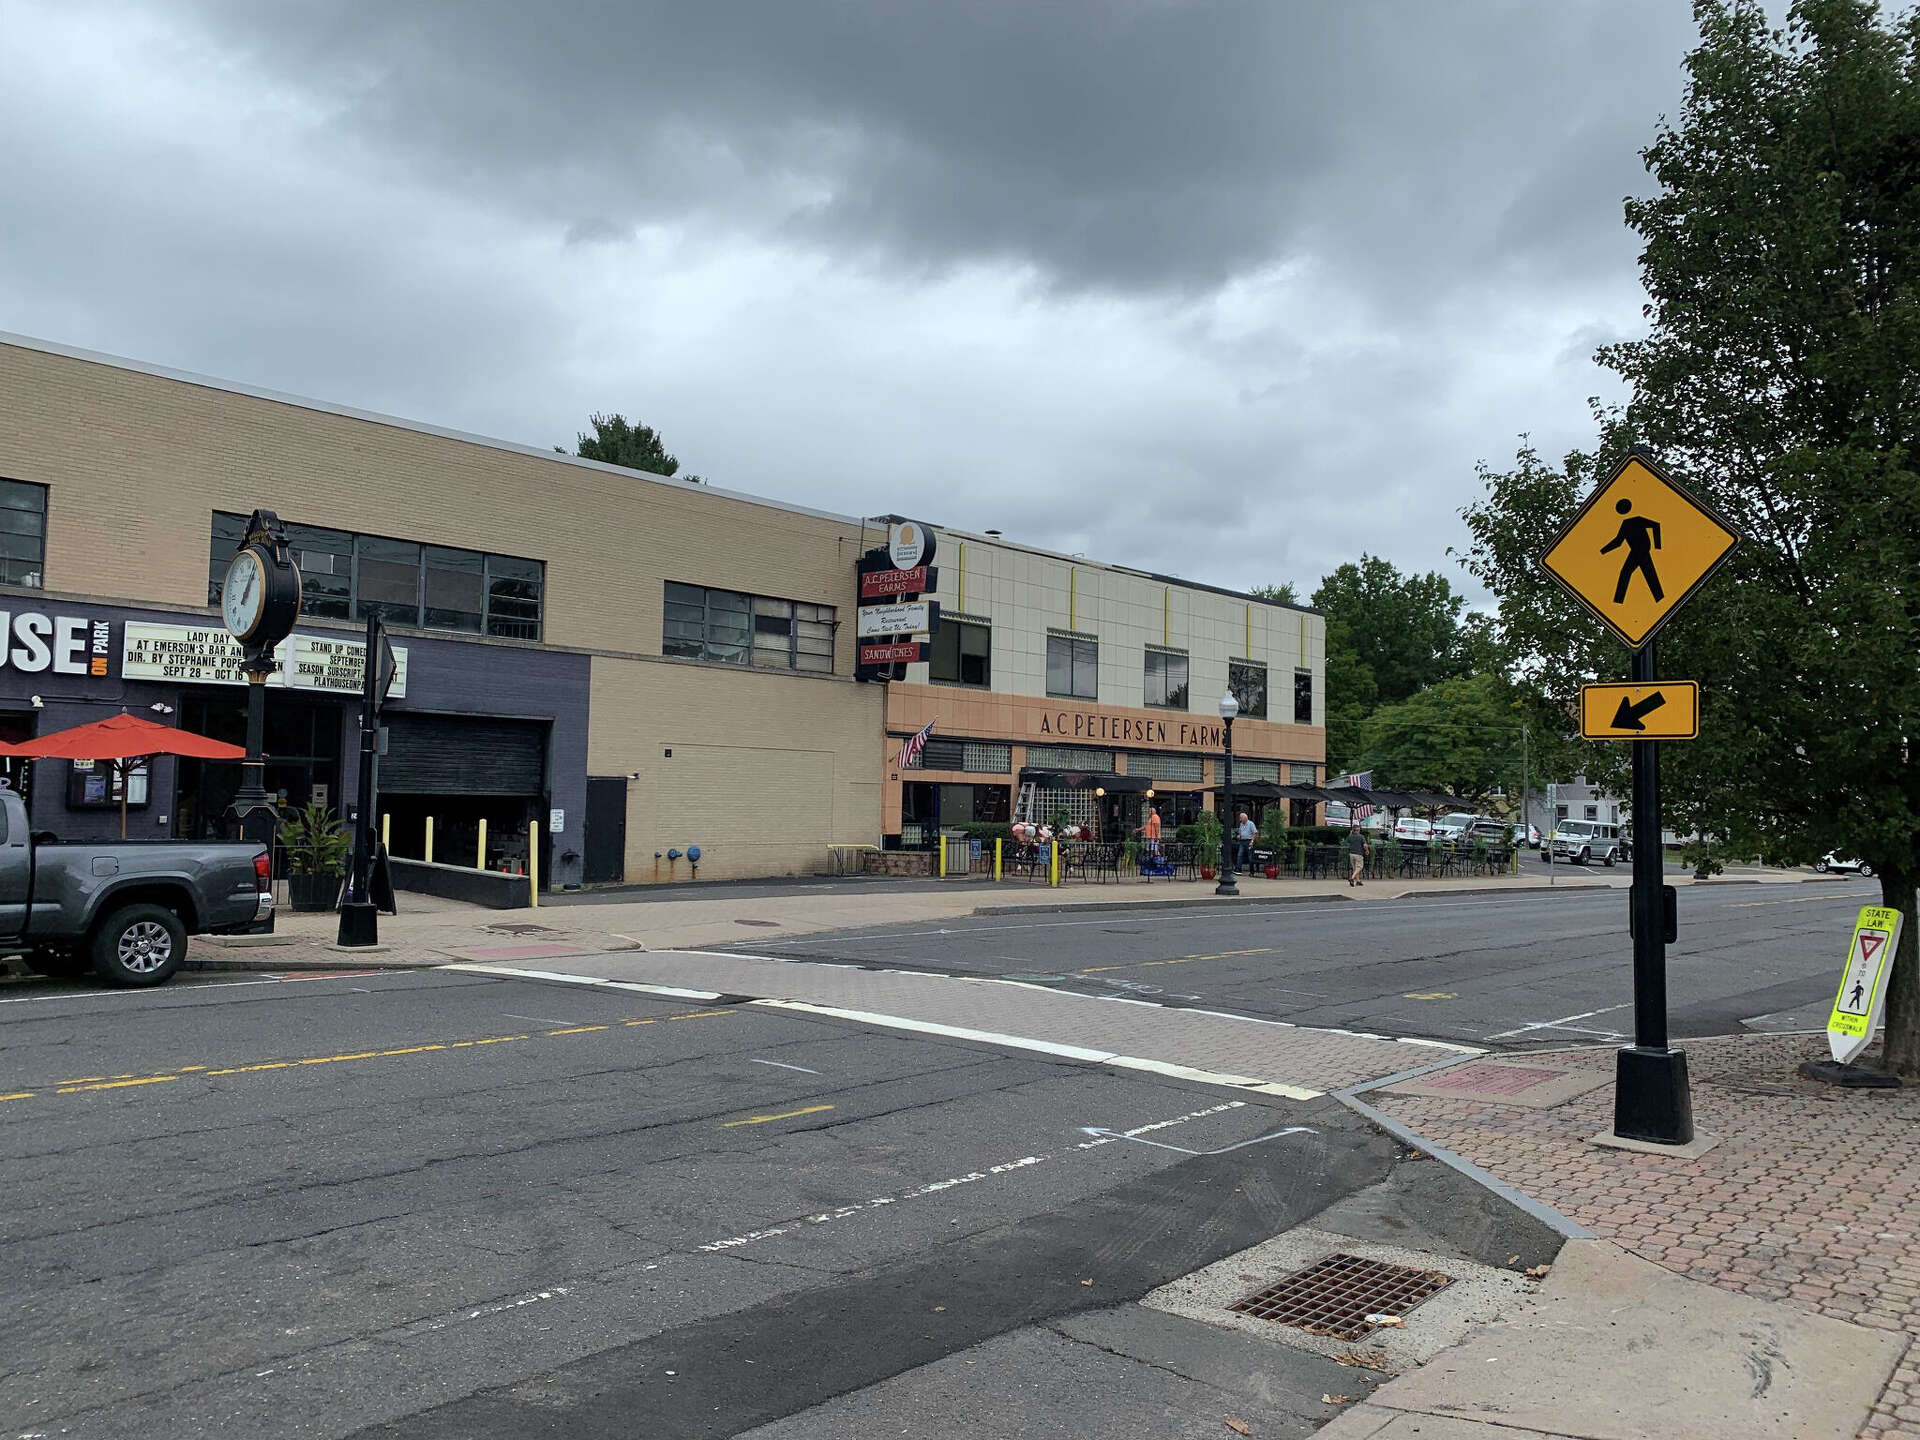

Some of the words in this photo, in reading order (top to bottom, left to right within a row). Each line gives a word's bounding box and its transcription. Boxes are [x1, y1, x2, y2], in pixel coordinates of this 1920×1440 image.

[878, 581, 907, 593] FARMS
[0, 610, 88, 675] SE
[92, 620, 109, 654] PARK
[187, 631, 210, 643] LADY
[213, 633, 230, 645] DAY
[136, 640, 148, 651] AT
[154, 641, 204, 655] EMERSON'S
[208, 644, 226, 656] BAR
[311, 641, 332, 654] STAND
[335, 644, 344, 655] UP
[864, 647, 913, 660] SANDWICHES
[127, 651, 146, 663] DIR.
[152, 653, 163, 664] BY
[168, 654, 217, 667] STEPHANIE
[90, 657, 108, 676] ON
[163, 665, 184, 677] SEPT
[189, 667, 201, 678] 28
[215, 668, 231, 680] OCT
[235, 670, 243, 681] 16
[298, 663, 324, 676] SEASON
[1866, 908, 1891, 920] STATE
[1867, 918, 1885, 928] LAW
